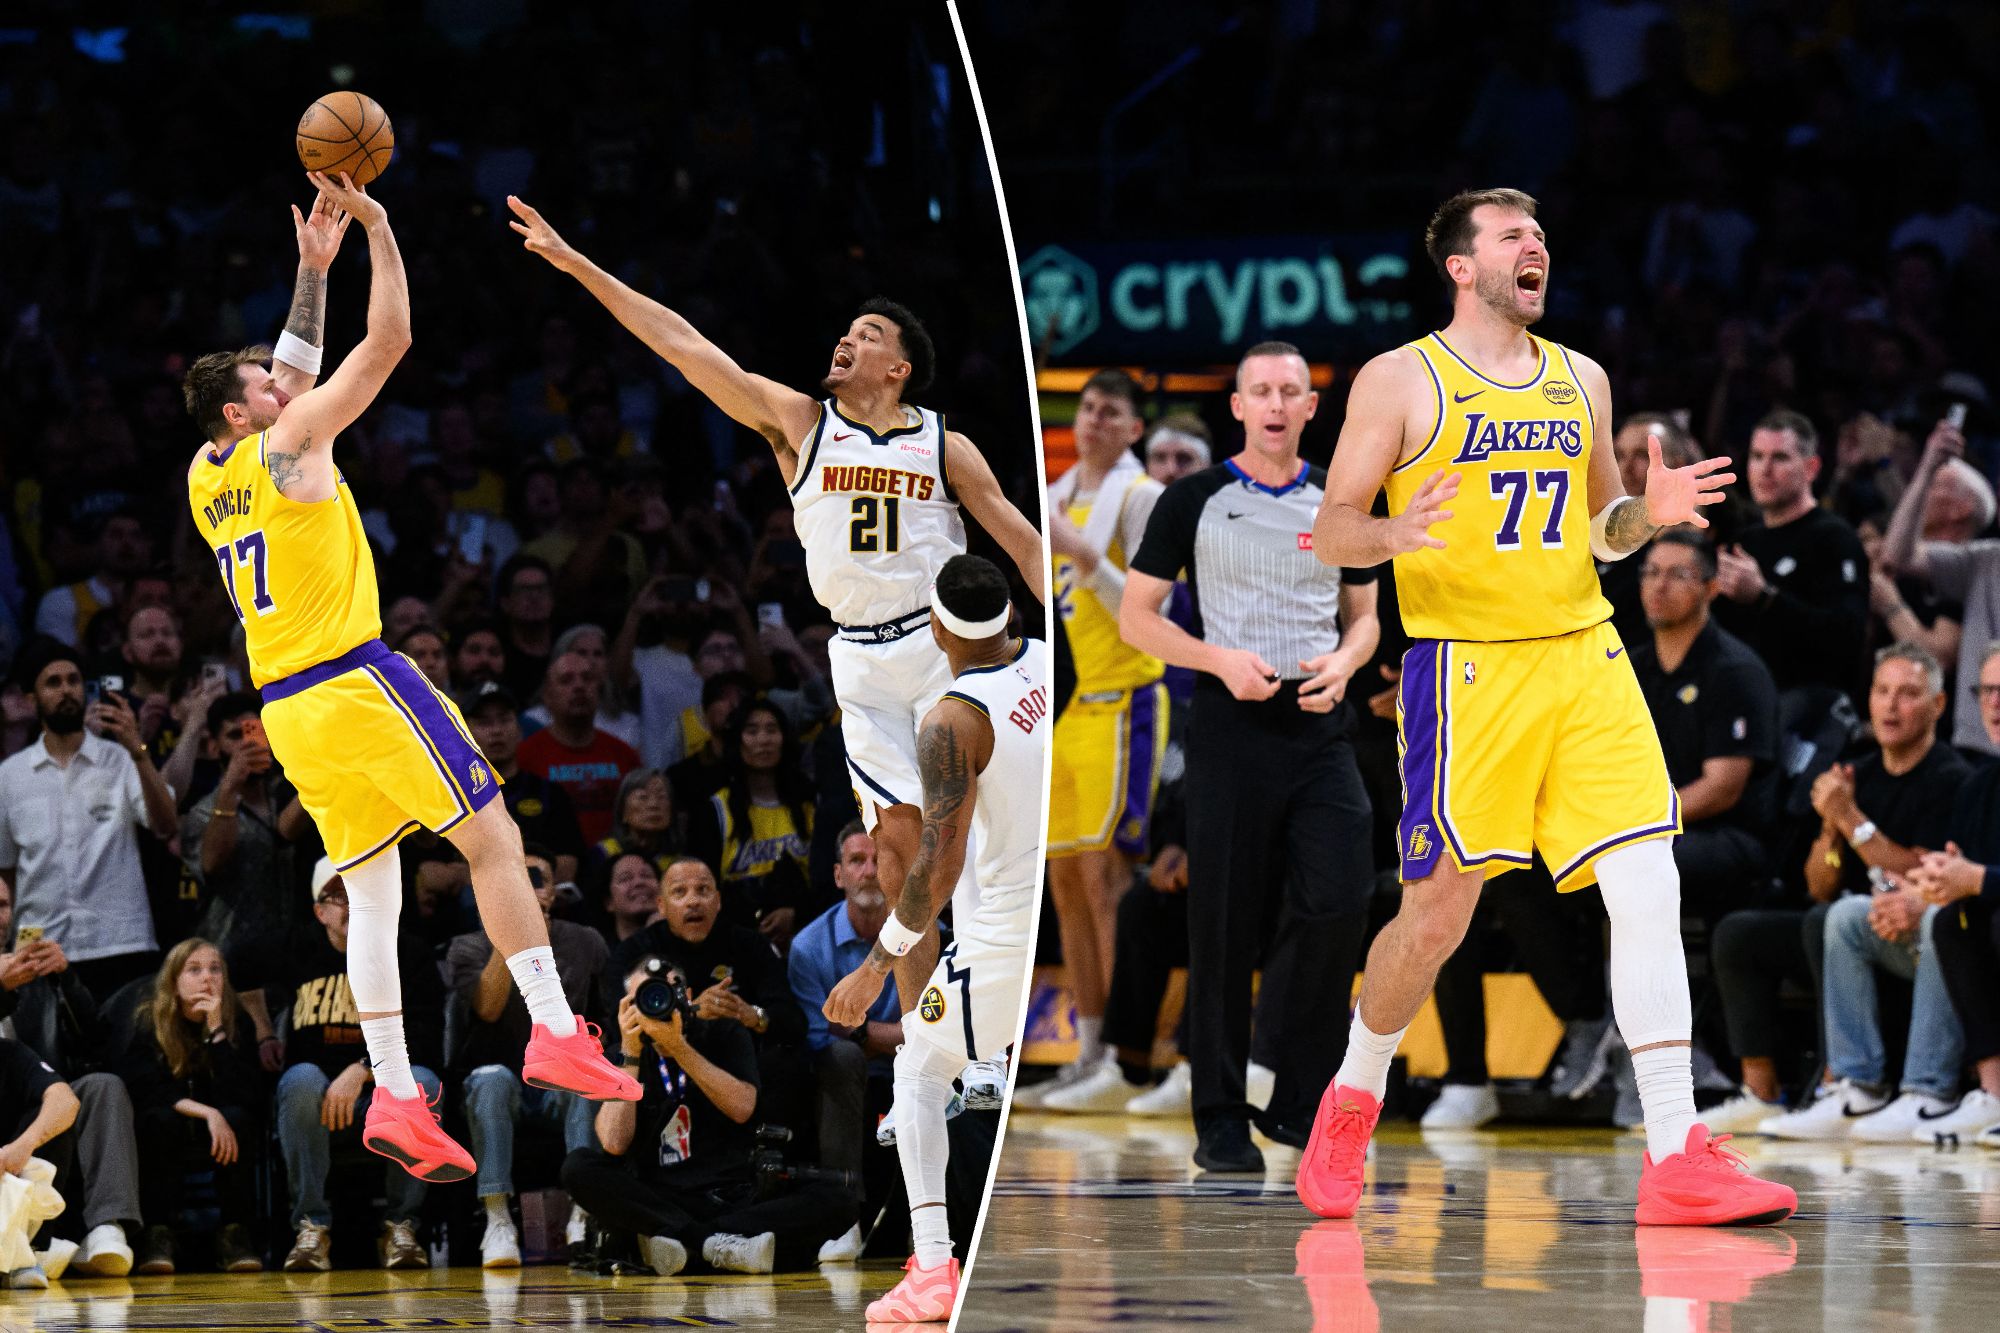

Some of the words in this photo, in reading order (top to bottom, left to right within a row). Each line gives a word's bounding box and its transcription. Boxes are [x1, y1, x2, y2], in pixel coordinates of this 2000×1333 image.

[1545, 387, 1575, 398] bibigo
[900, 443, 931, 456] ibotta
[1451, 412, 1584, 465] LAKERS
[203, 484, 252, 531] DONČIĆ
[822, 465, 936, 501] NUGGETS
[850, 494, 899, 553] 21
[1488, 468, 1571, 552] 77
[216, 528, 277, 625] 77
[1008, 685, 1047, 735] BRO
